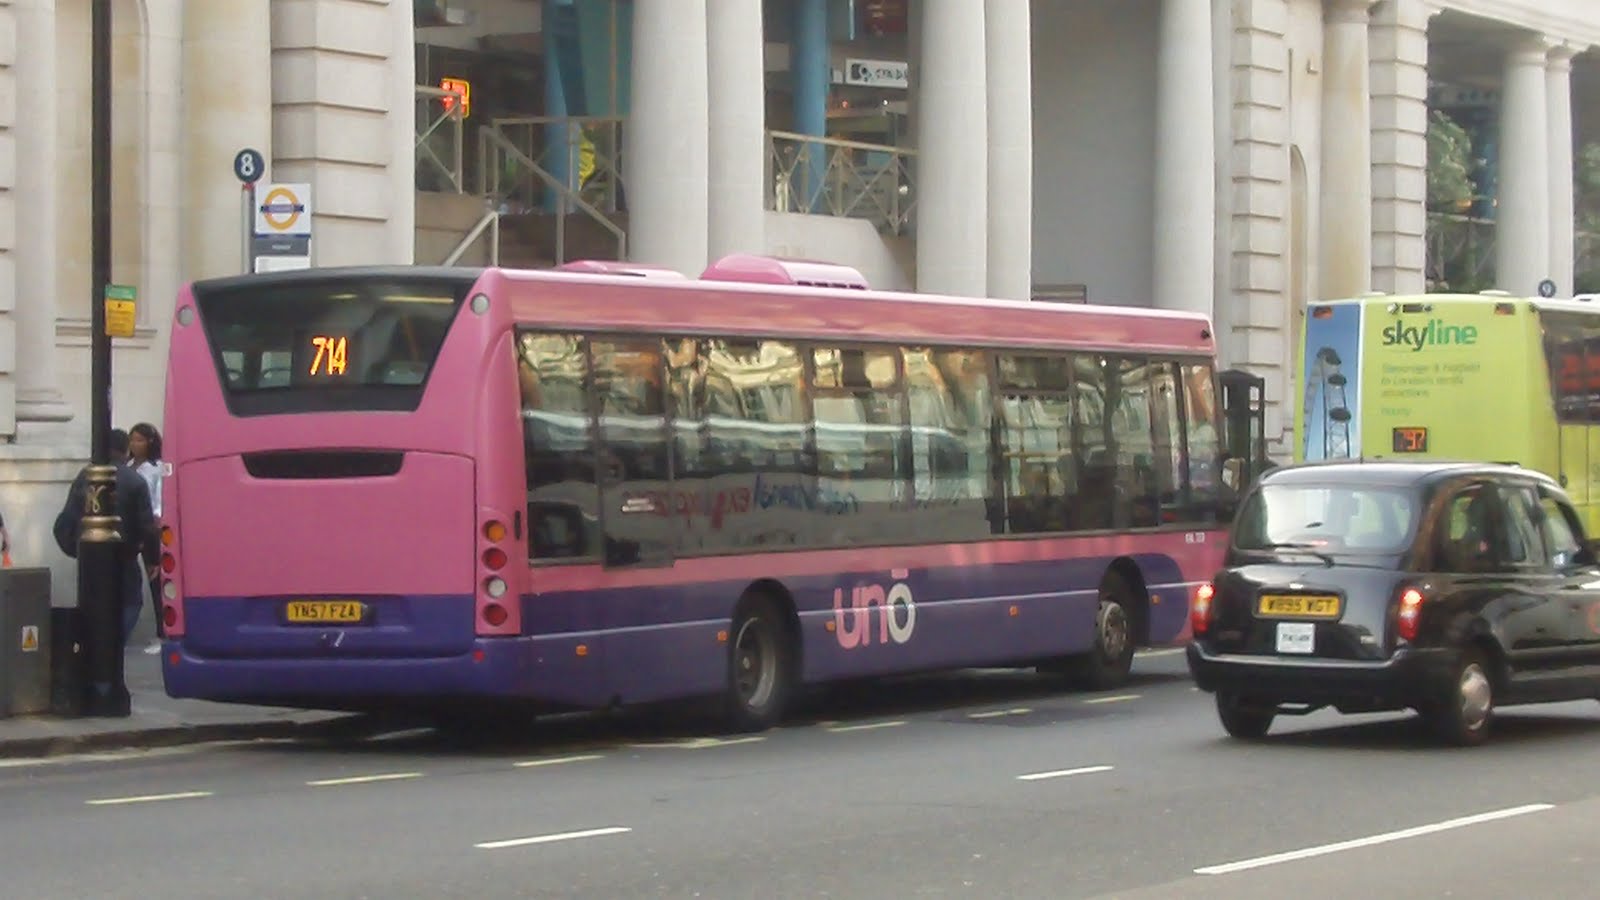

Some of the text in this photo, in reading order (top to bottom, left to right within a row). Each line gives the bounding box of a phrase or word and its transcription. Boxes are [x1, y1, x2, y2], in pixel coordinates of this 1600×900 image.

[241, 153, 254, 176] 8
[1382, 319, 1478, 352] skyline
[310, 336, 347, 376] 714
[293, 603, 356, 618] YN57 FZA
